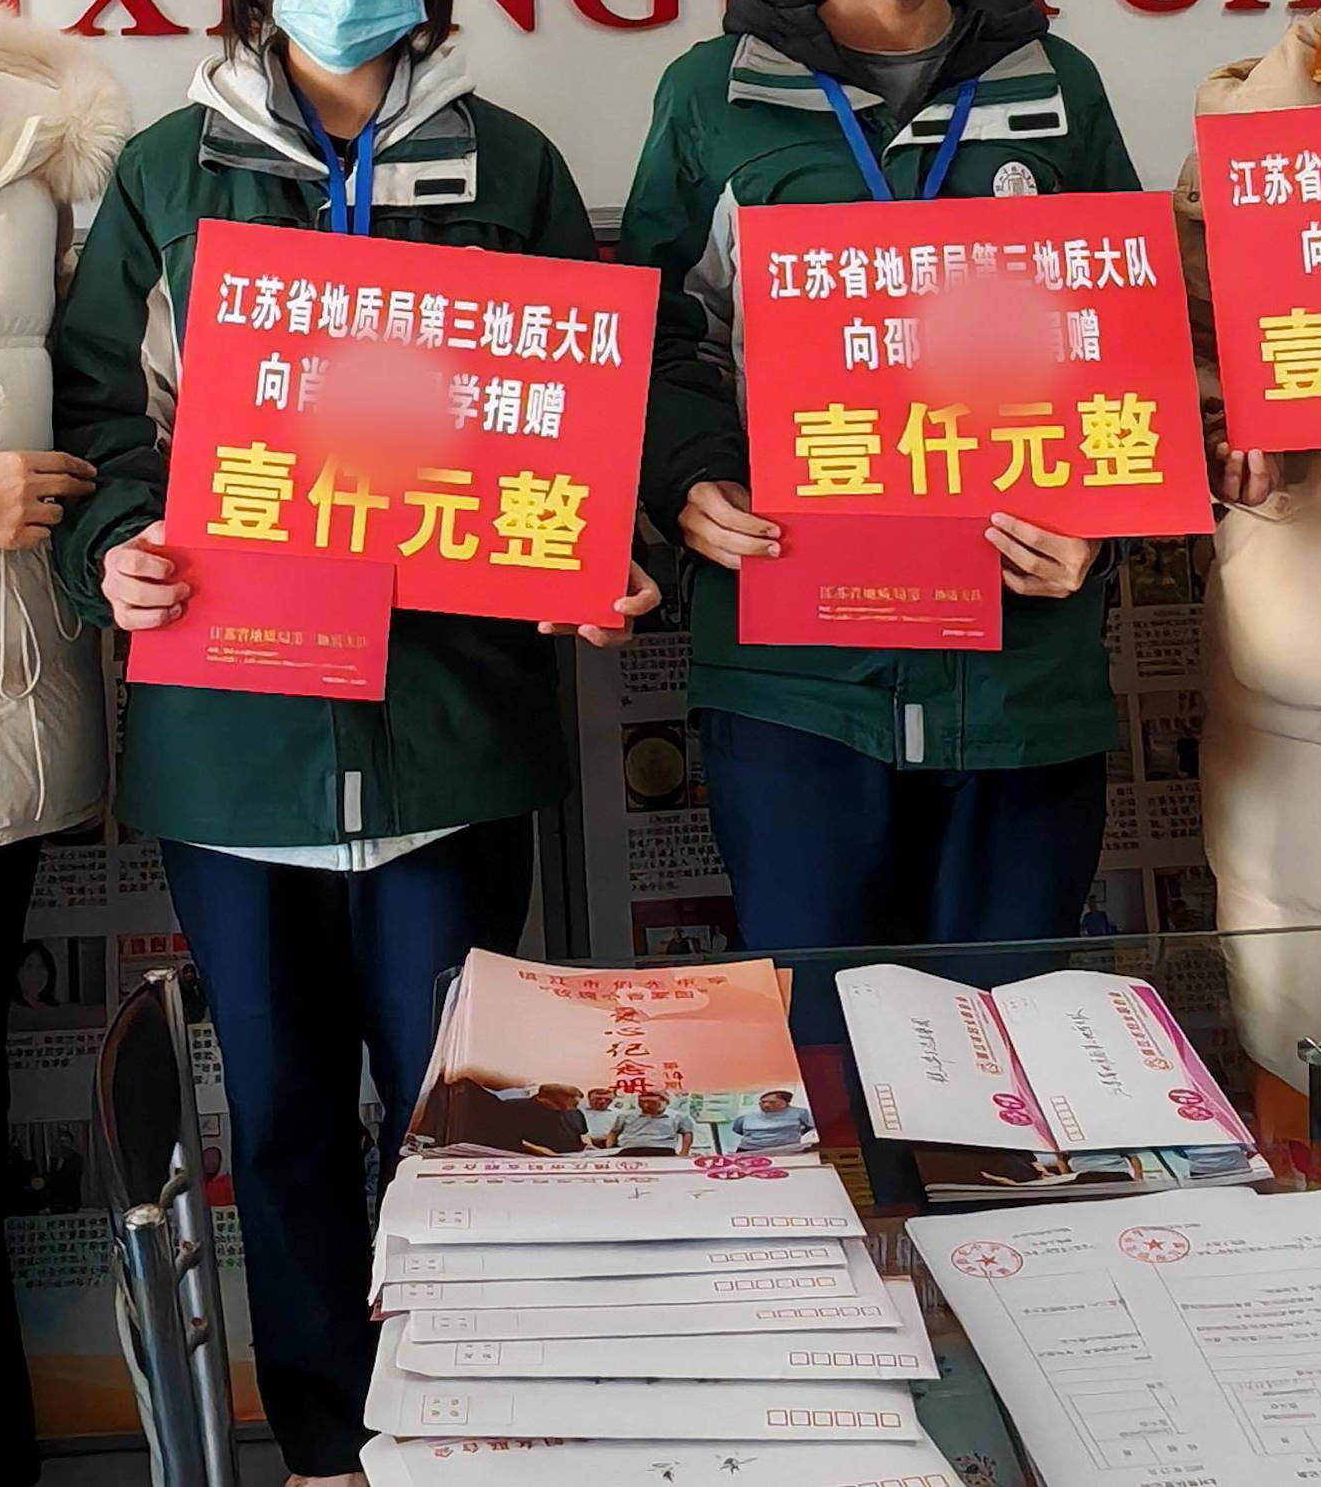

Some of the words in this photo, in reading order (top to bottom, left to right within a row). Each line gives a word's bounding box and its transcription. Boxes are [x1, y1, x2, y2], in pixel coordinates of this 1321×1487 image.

[768, 235, 1157, 299] 江苏省地质局第三地质大队
[216, 273, 623, 368] 江苏省地质局第三地质大队
[793, 393, 1164, 497] 壹仟元整
[206, 441, 590, 571] 壹仟元整
